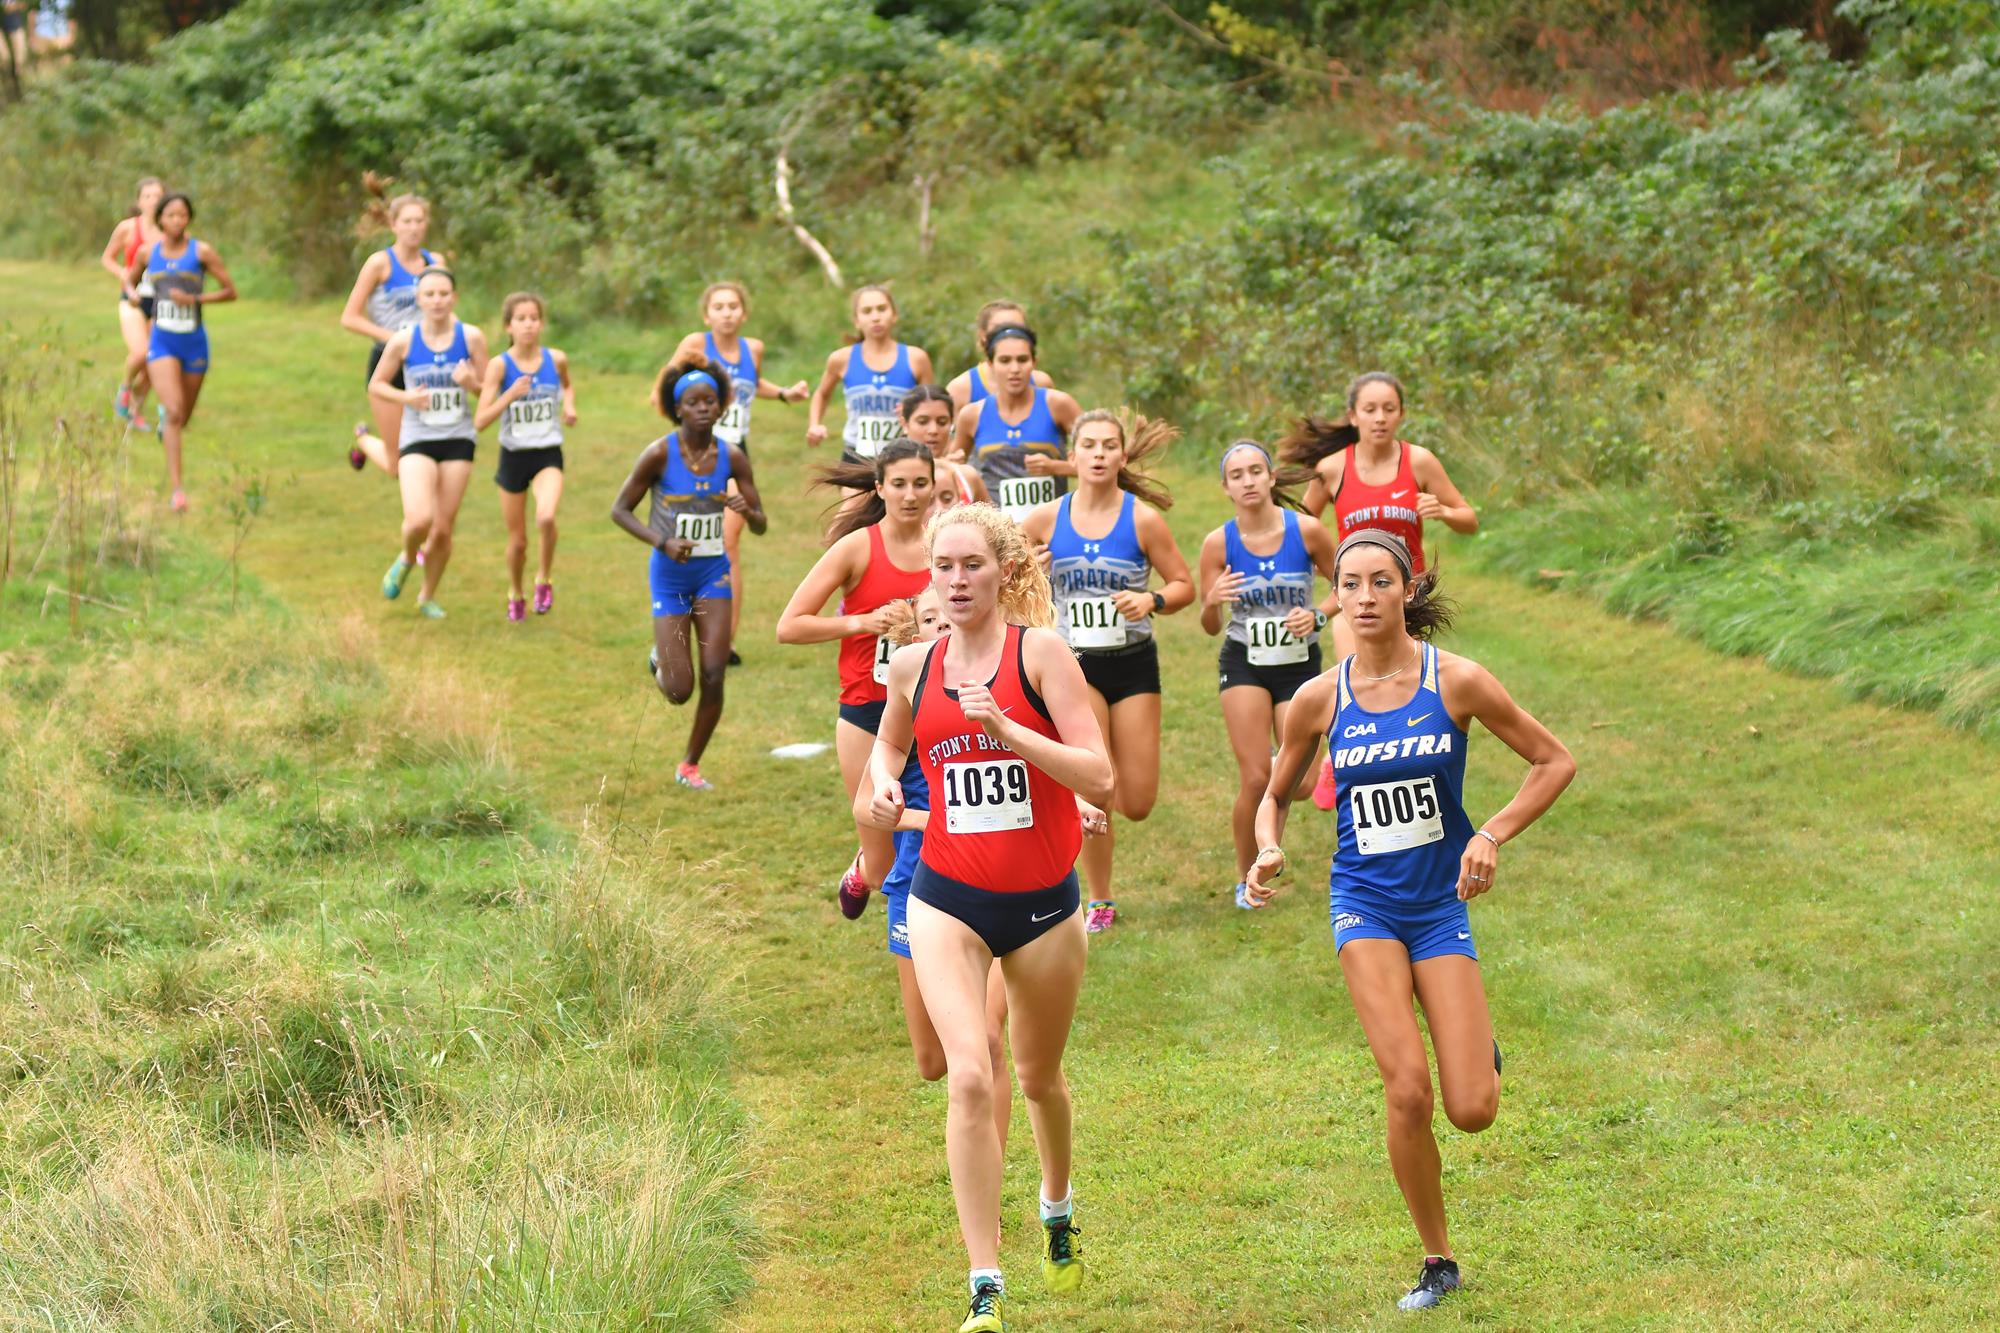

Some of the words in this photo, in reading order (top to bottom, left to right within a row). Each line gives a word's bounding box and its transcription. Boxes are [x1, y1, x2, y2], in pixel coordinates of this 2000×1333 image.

[428, 391, 461, 412] 014
[514, 401, 553, 423] 1023
[1004, 480, 1053, 507] 1008
[679, 518, 722, 541] 1010
[1343, 506, 1379, 529] STONY
[1382, 505, 1418, 526] BROOK
[1058, 567, 1130, 593] PIRATES
[1070, 601, 1121, 628] 1017
[1343, 722, 1377, 739] CAA
[928, 734, 971, 768] STONY
[1334, 733, 1452, 769] HOFSTRA
[946, 764, 1028, 807] 1039
[1353, 782, 1437, 829] 1005
